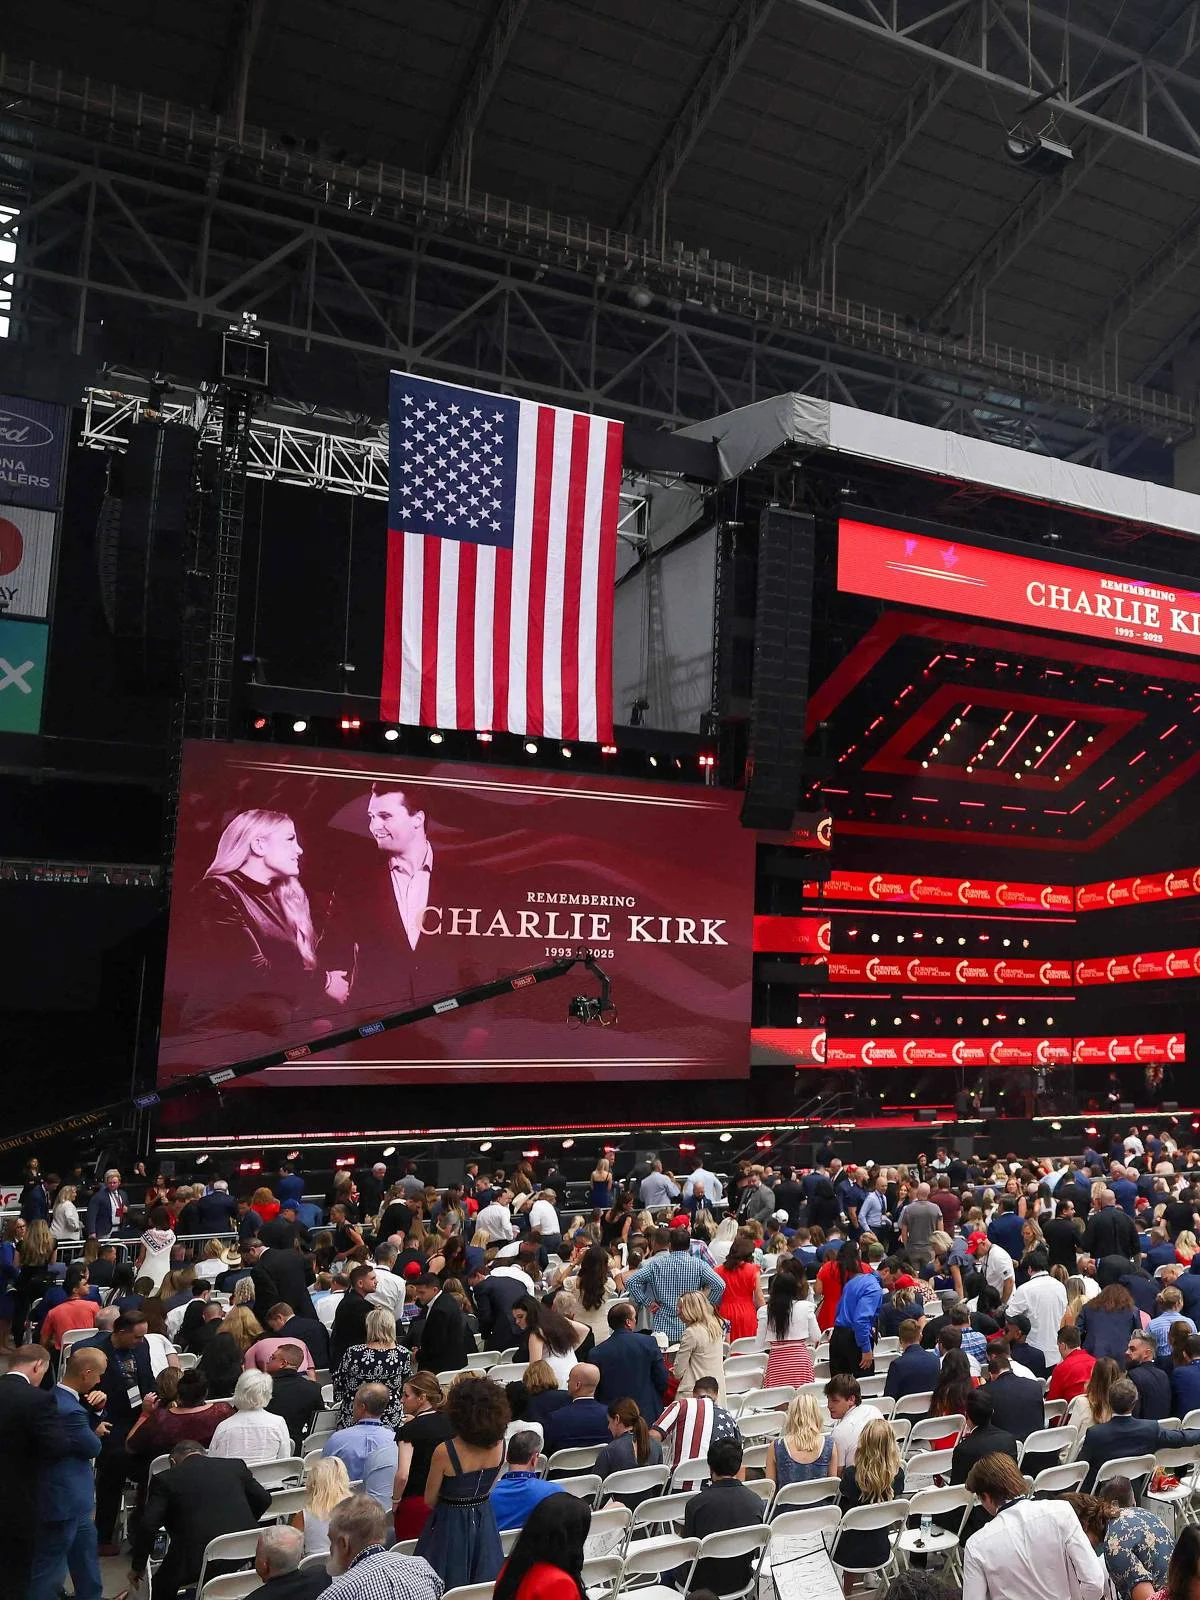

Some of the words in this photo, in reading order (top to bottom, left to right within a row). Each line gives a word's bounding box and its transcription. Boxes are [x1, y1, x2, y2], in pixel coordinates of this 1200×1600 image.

[1100, 579, 1176, 602] REMEMBERING
[1026, 581, 1160, 628] CHARLIE
[527, 891, 636, 908] REMEMBERING
[419, 905, 612, 941] CHARLIE
[627, 915, 729, 945] KIRK
[545, 947, 572, 958] 1993
[0, 1135, 33, 1151] ERICA
